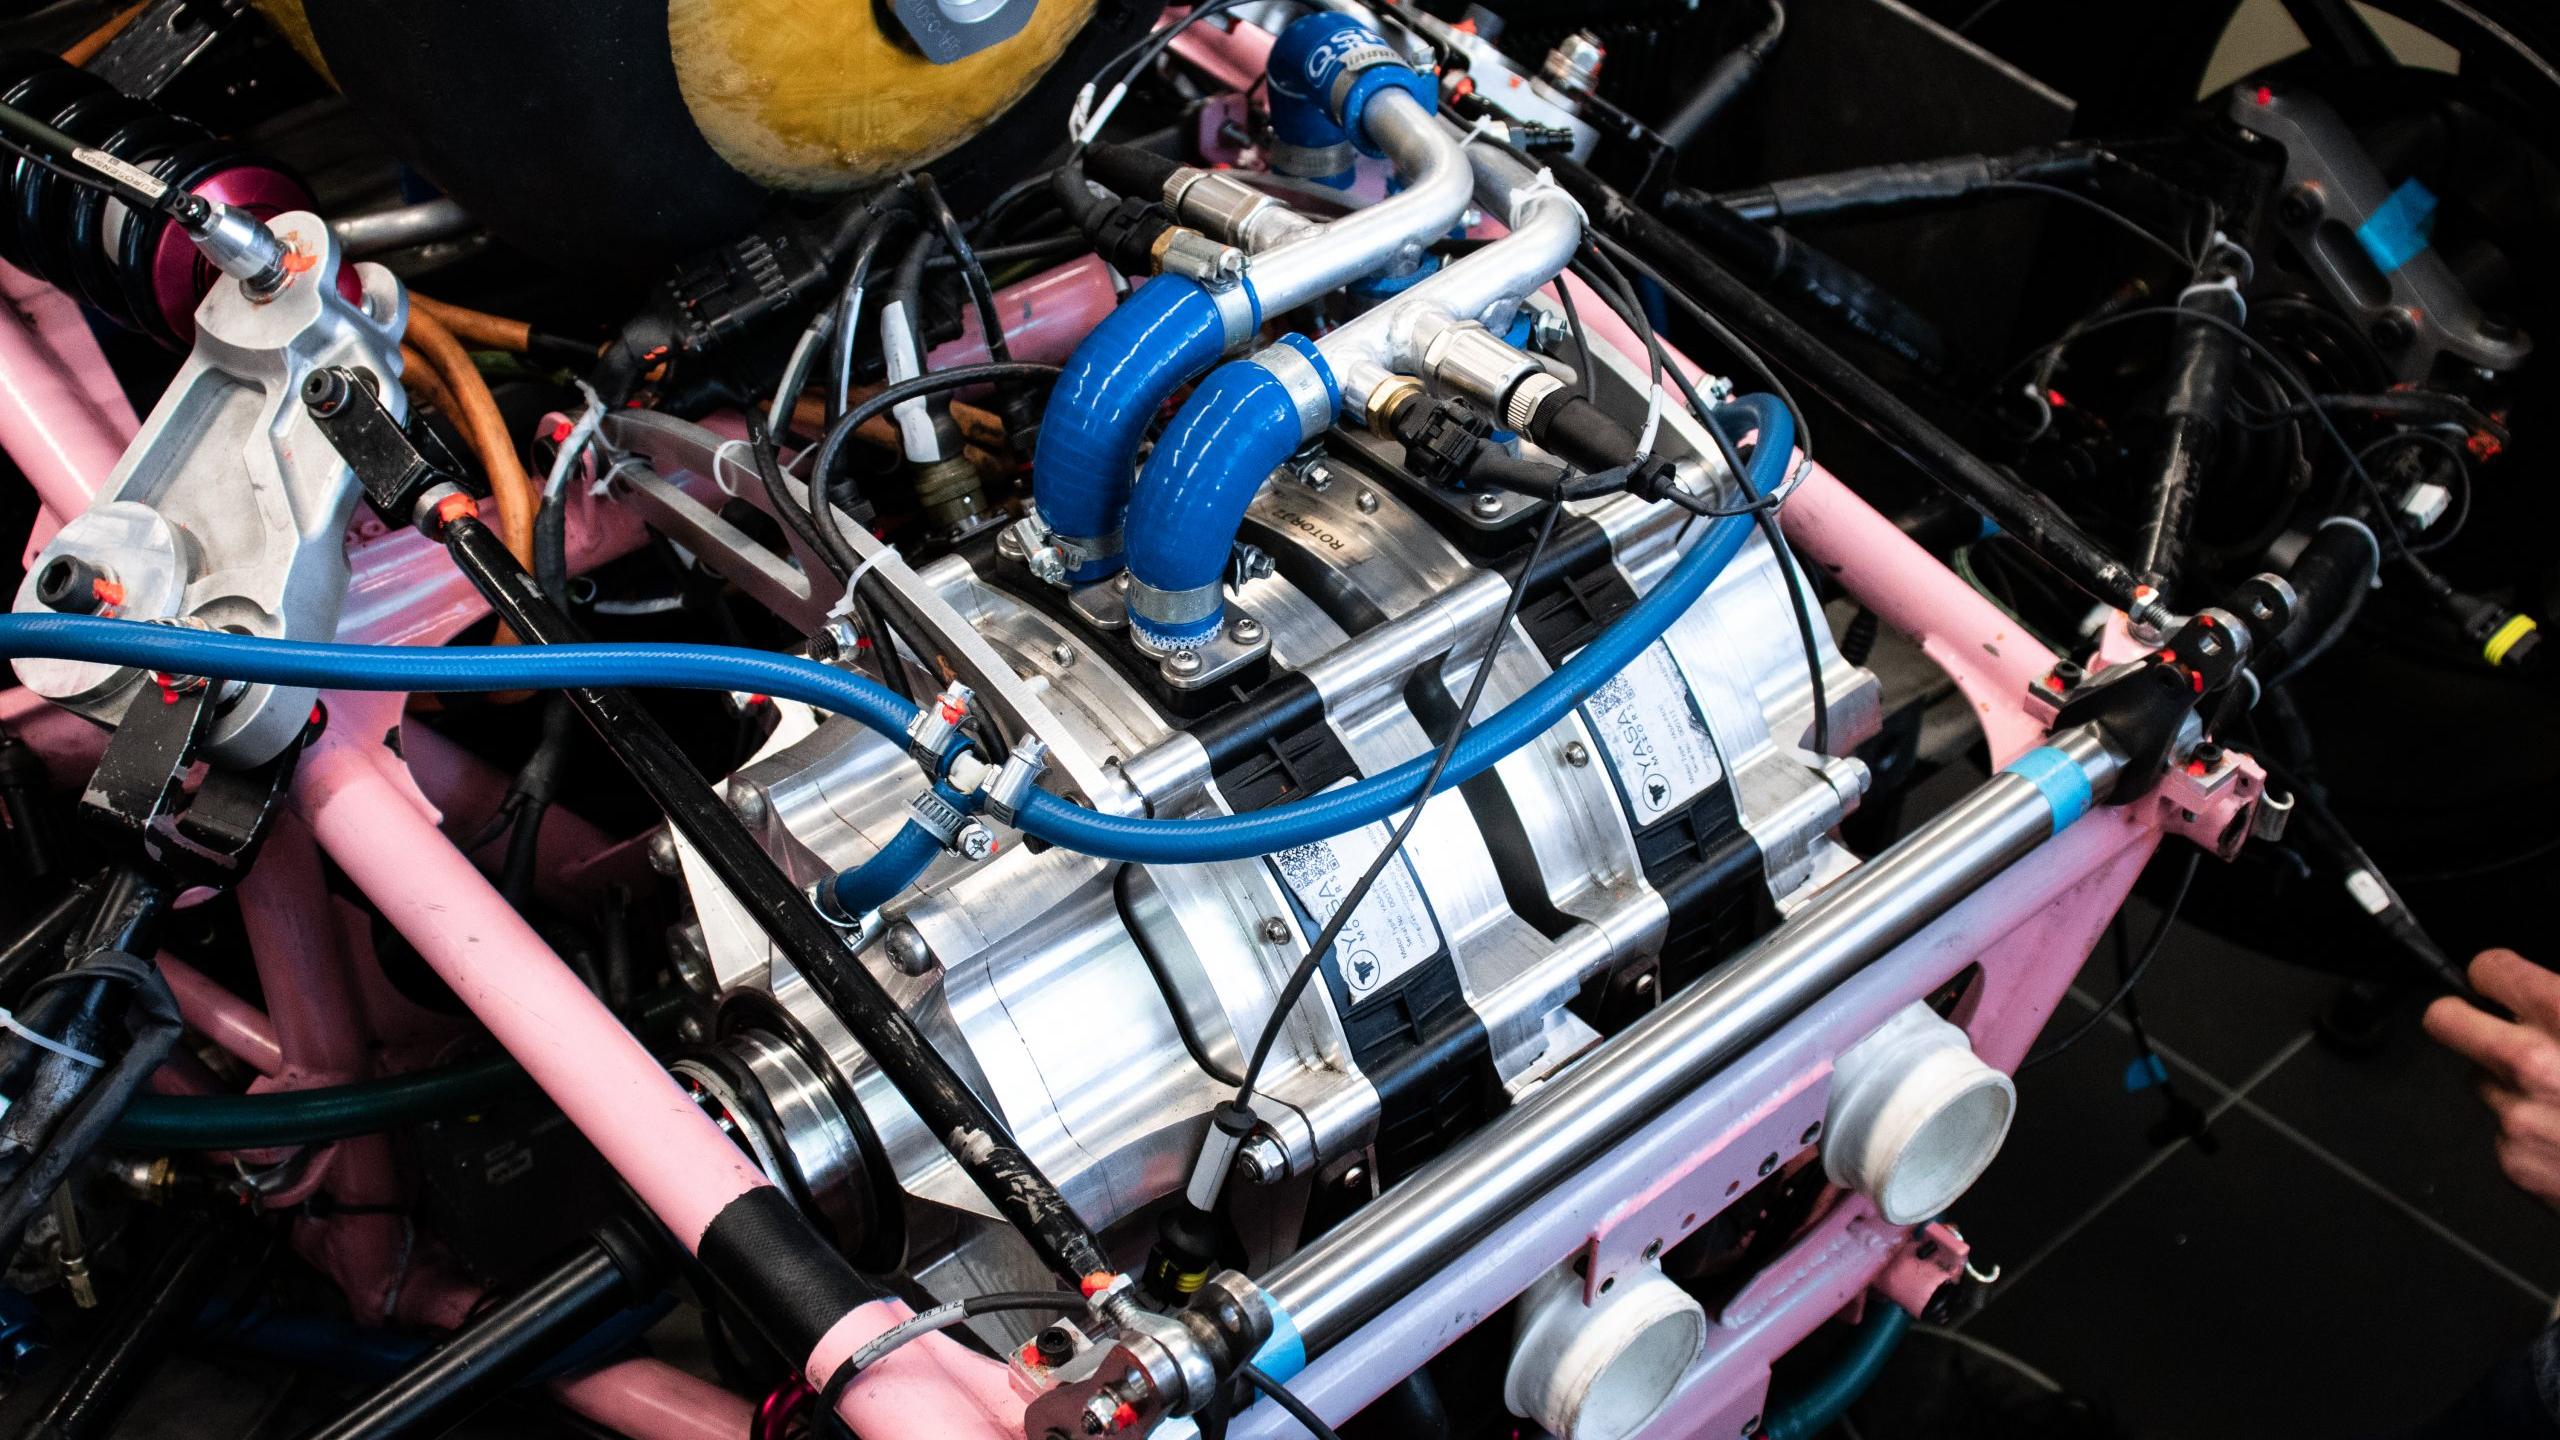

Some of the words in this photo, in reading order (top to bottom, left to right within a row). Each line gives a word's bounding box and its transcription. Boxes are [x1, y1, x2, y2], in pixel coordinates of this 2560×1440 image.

[1617, 708, 1649, 776] YASA
[1625, 701, 1659, 765] MOTORS
[1328, 873, 1366, 941] MORS
